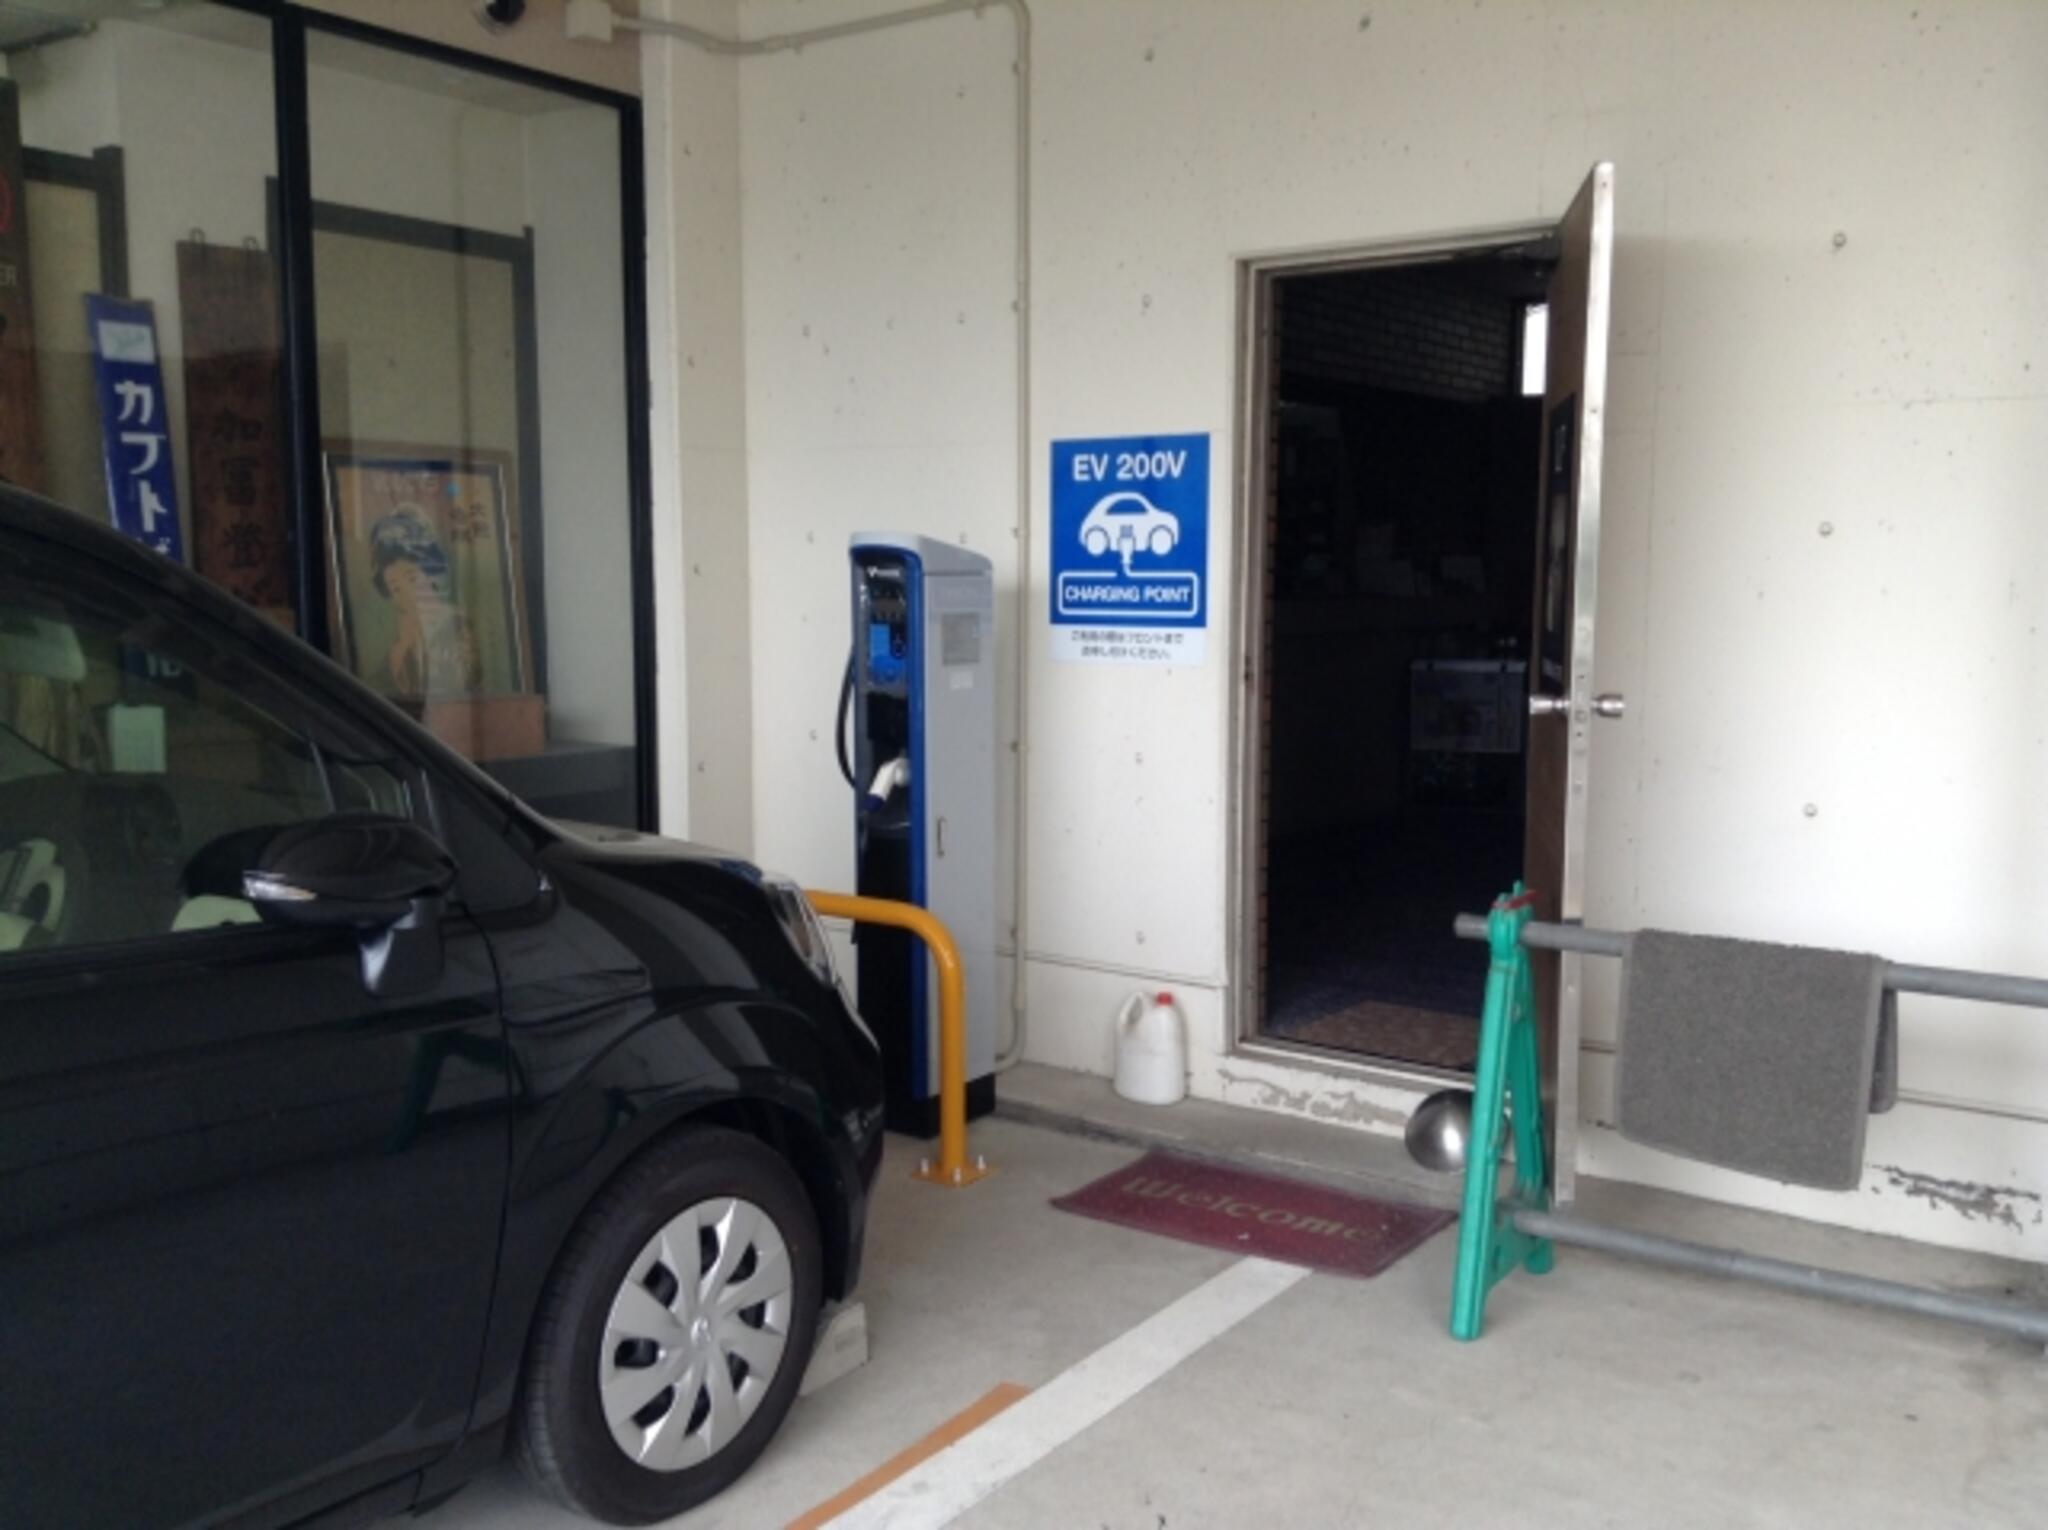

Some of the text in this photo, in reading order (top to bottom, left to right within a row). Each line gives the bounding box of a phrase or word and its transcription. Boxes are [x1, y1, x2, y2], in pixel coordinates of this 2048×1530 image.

[1073, 450, 1187, 481] EV 200V
[1065, 585, 1192, 602] CHARGING POINT
